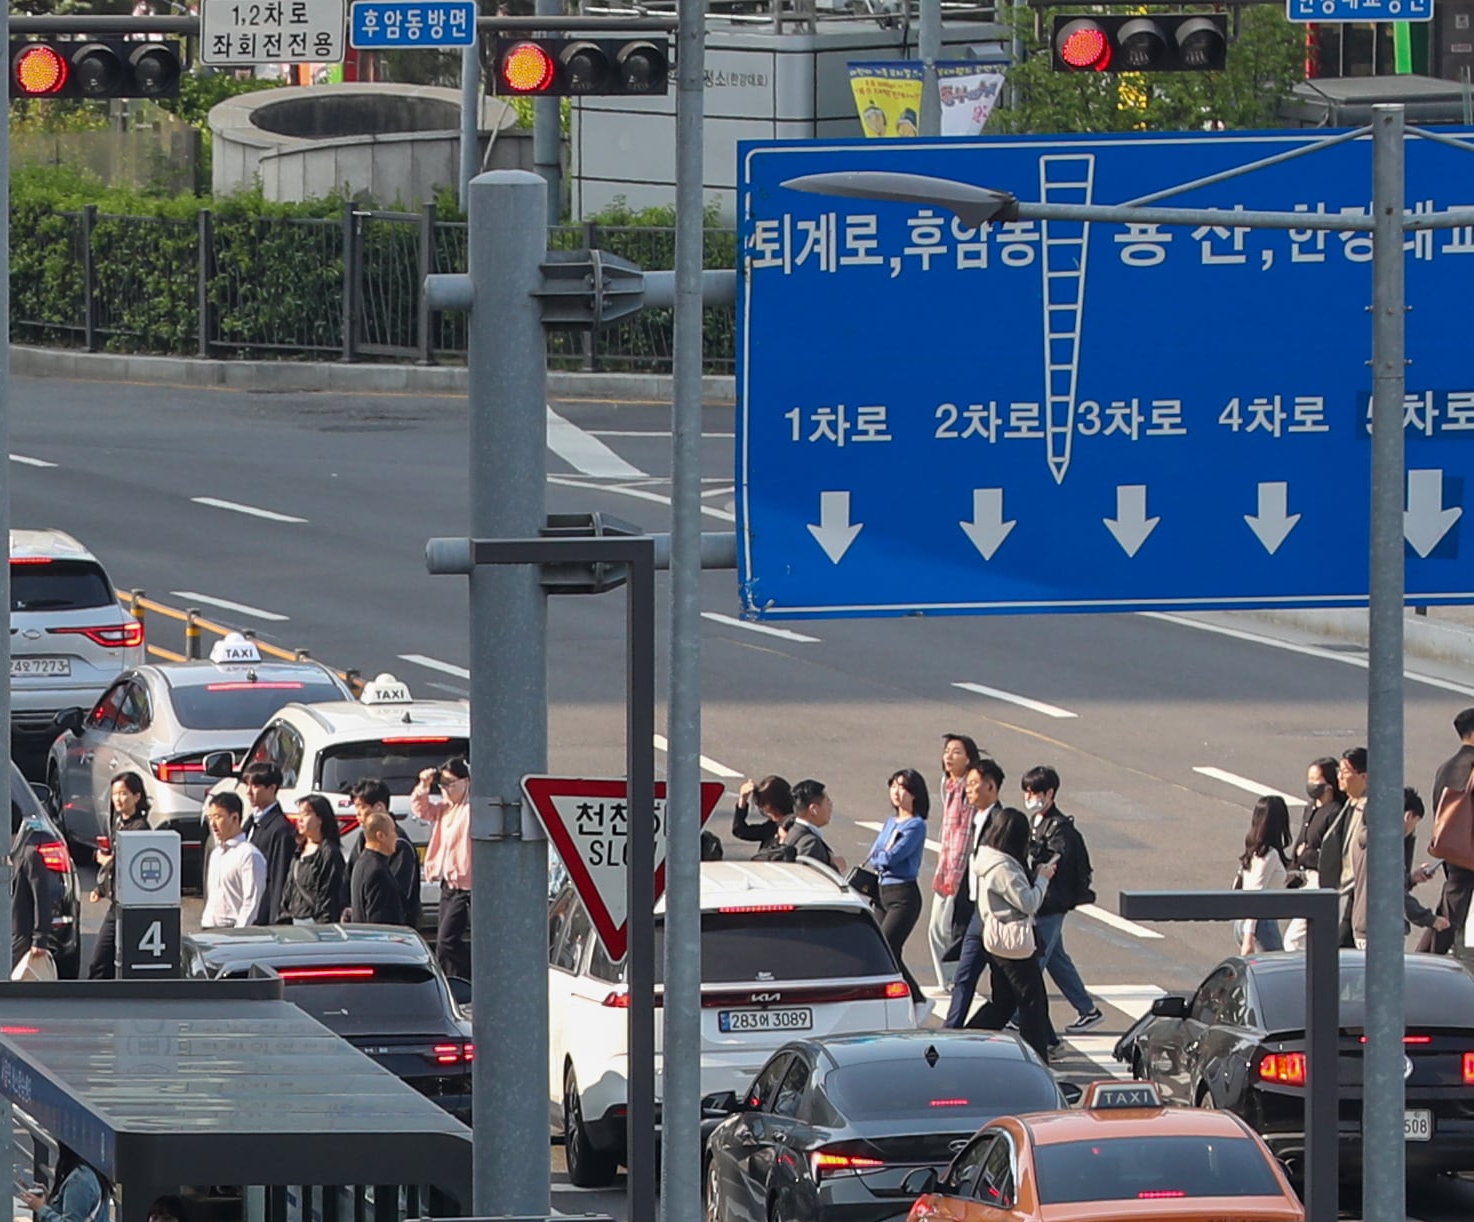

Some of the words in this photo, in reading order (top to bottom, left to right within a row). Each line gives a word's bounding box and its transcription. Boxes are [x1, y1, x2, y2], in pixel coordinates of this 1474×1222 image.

[361, 8, 467, 40] 후암동방면
[784, 404, 892, 446] 1차로
[934, 402, 1045, 443] 2차로
[1077, 398, 1188, 440] 3차로
[1219, 394, 1330, 437] 4차로
[1365, 392, 1474, 436] 차로
[224, 647, 254, 660] TAXI
[374, 689, 405, 701] TAXI
[138, 921, 165, 957] 4
[1102, 1090, 1150, 1106] TAXI
